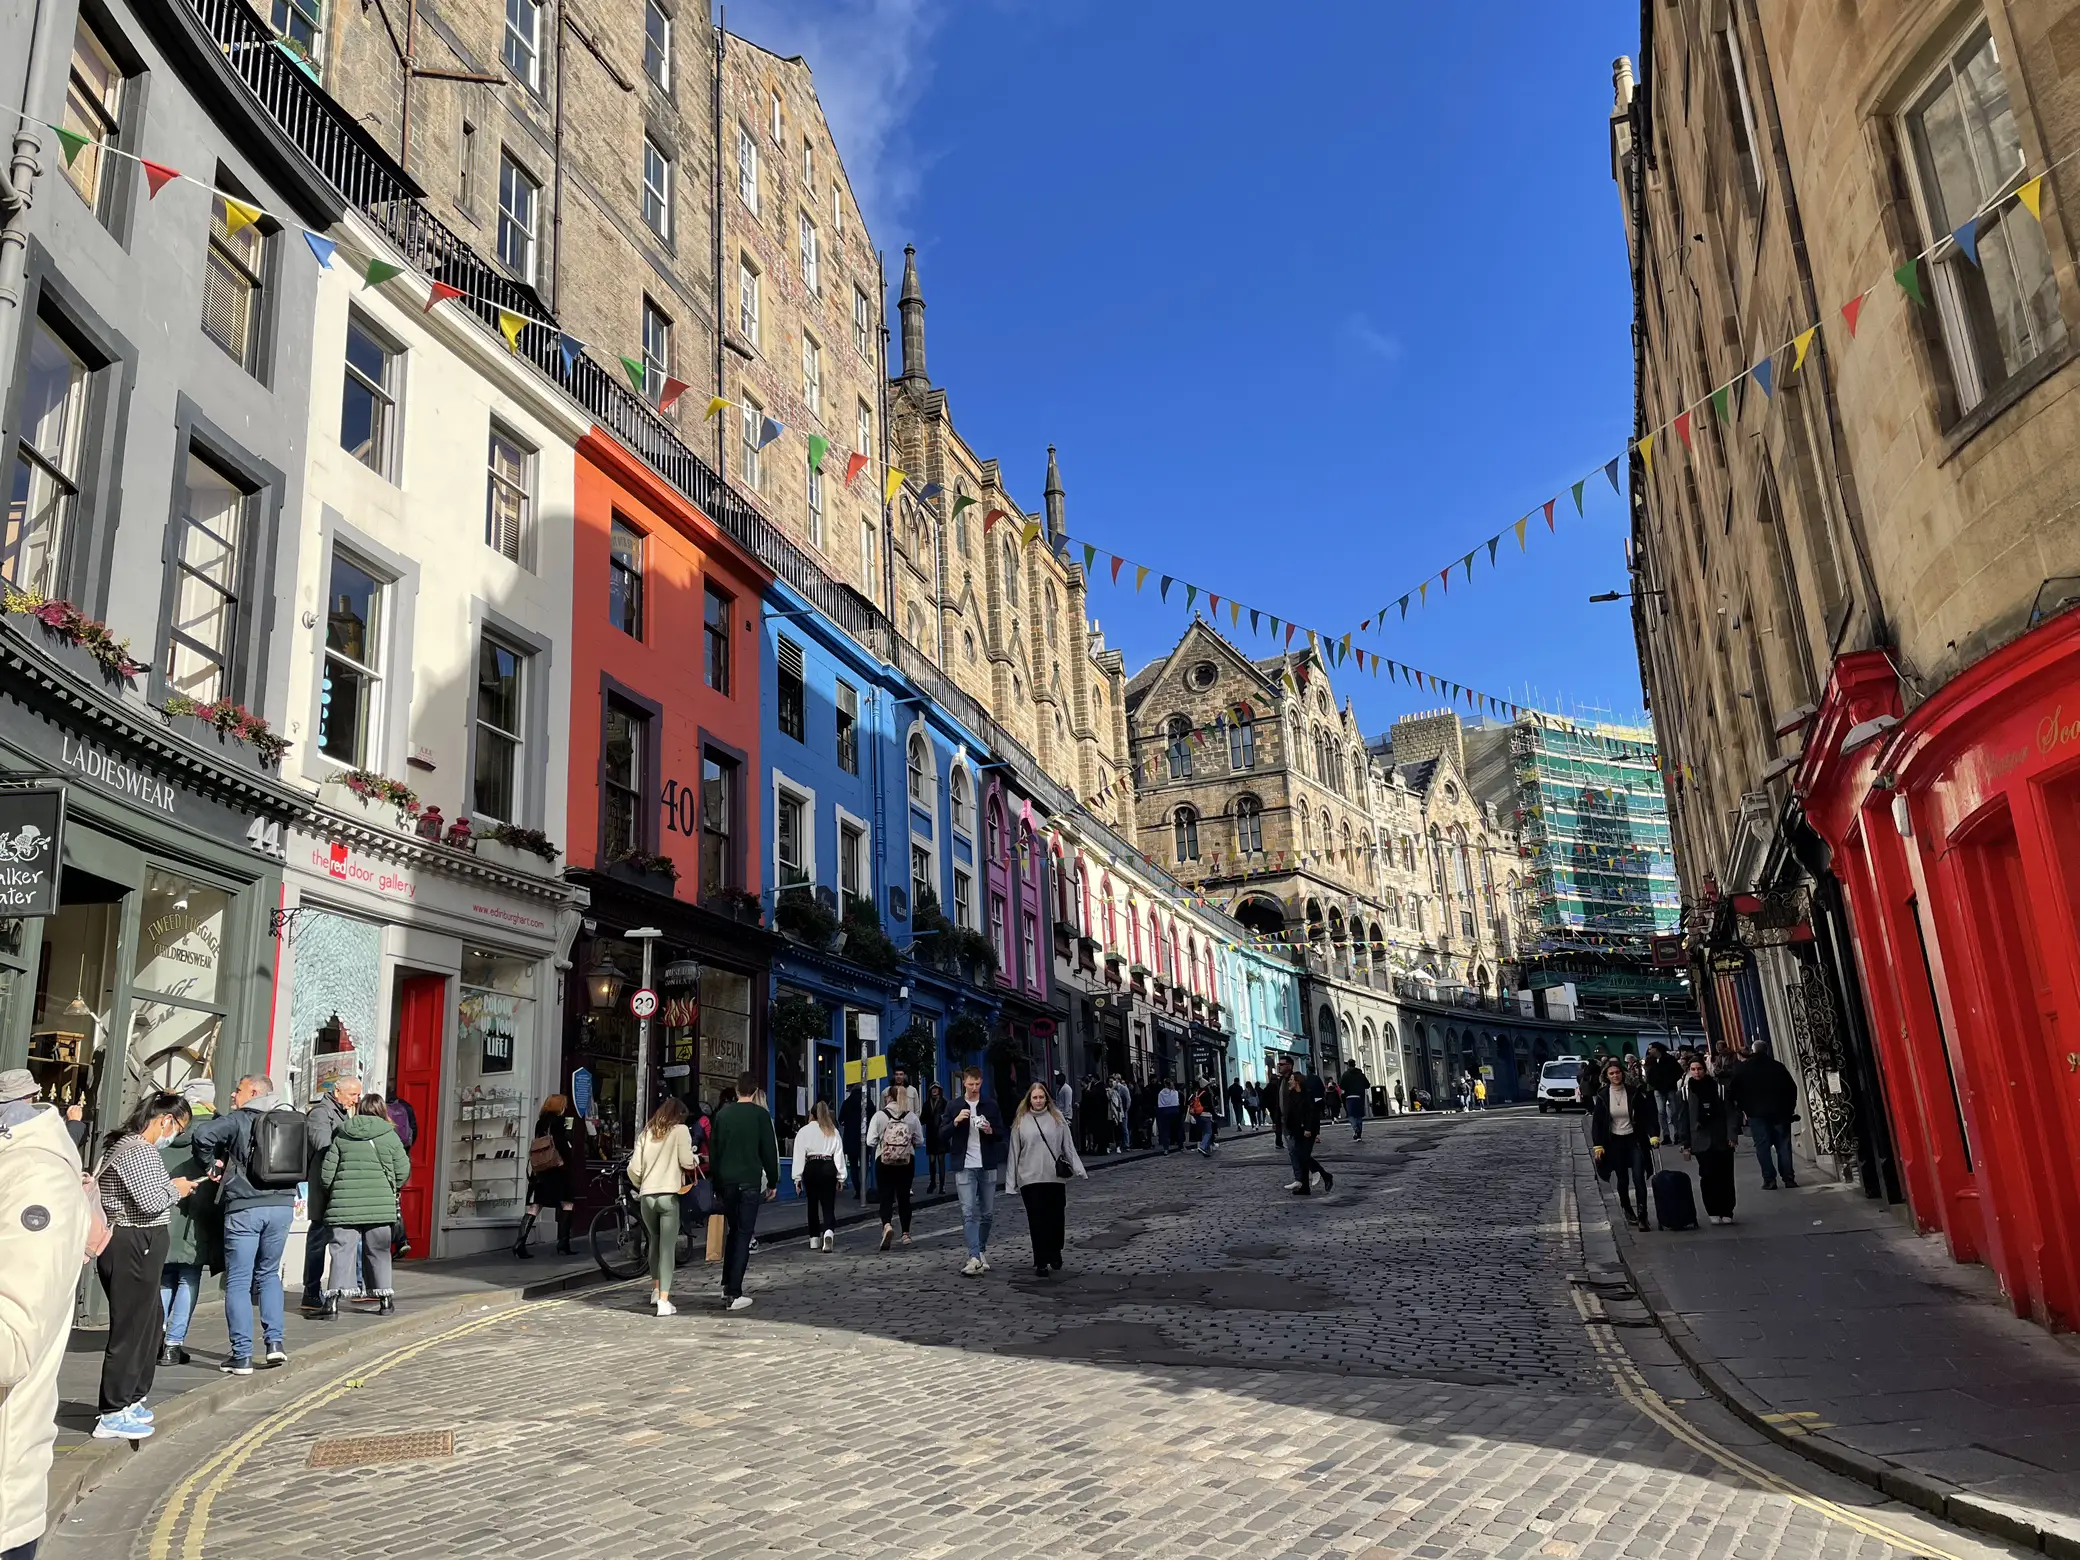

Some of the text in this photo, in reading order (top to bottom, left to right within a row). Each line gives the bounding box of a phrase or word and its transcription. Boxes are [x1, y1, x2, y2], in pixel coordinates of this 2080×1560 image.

[61, 736, 175, 813] LADIESWEAR
[661, 779, 695, 837] 40
[312, 849, 416, 898] the red door gallery
[472, 904, 544, 929] www.edinburghart.com
[145, 913, 220, 959] TWEED LUGGAGE
[181, 934, 190, 946] &
[153, 943, 212, 970] CHILDRENSWEAR
[635, 997, 654, 1009] 20
[486, 1037, 509, 1059] LIFE!
[707, 1036, 744, 1063] MUSEUM
